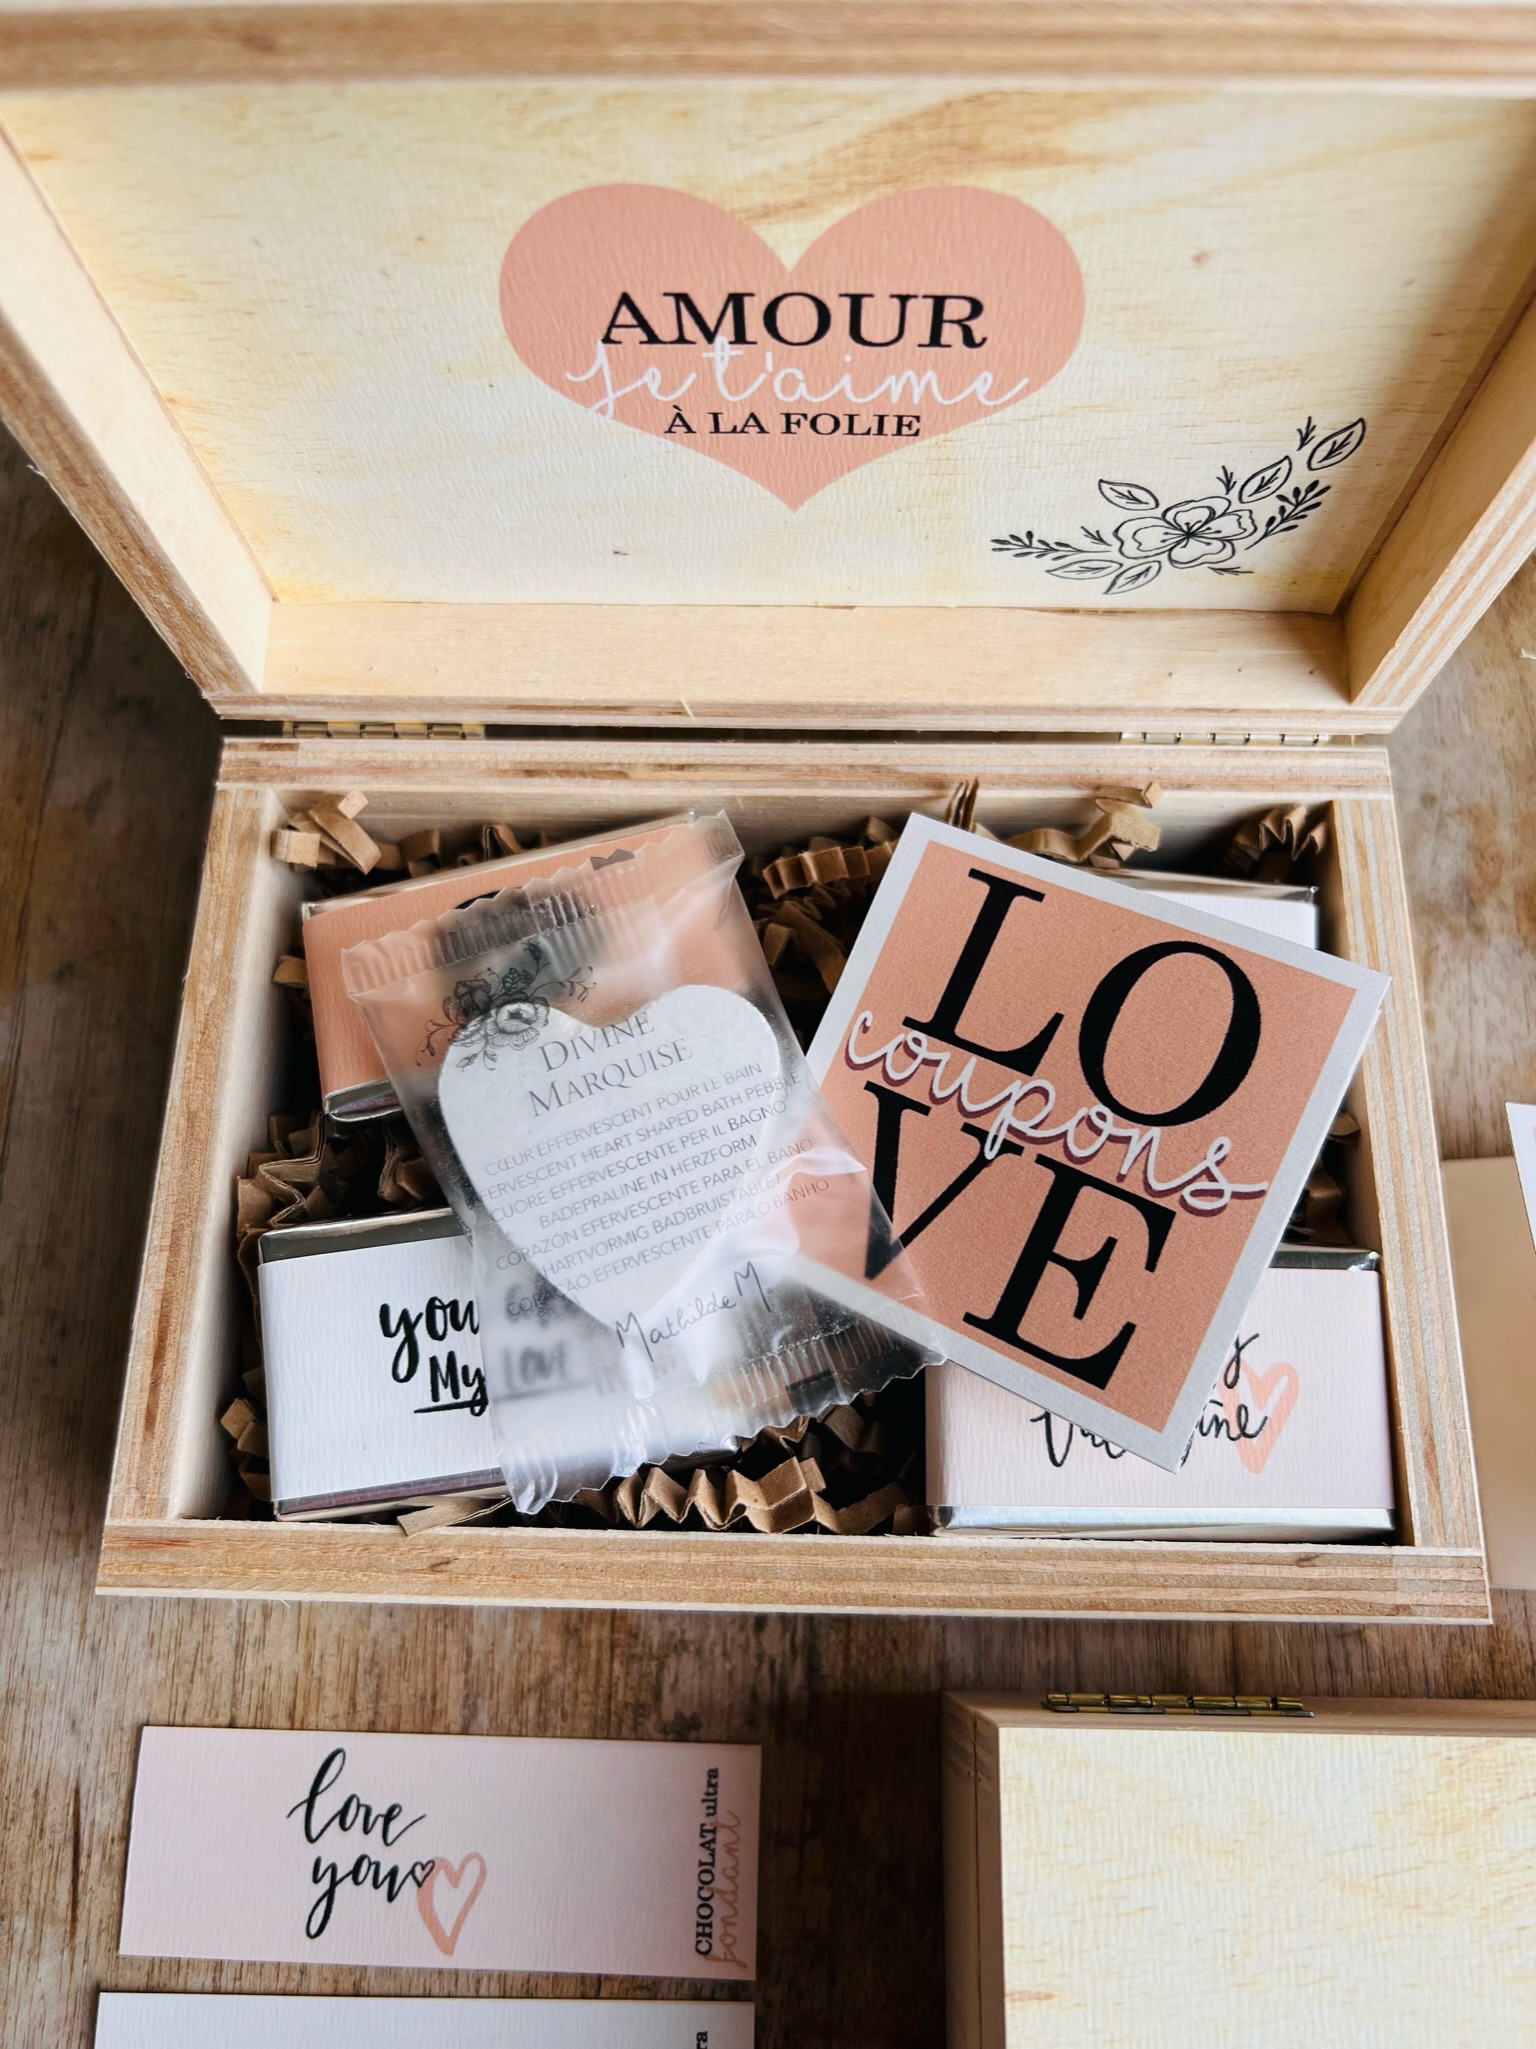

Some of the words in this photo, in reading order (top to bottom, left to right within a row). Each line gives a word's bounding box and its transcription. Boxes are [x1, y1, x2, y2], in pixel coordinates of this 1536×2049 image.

[601, 291, 988, 349] AMOUR
[664, 404, 696, 435] À
[708, 412, 770, 435] LA
[780, 412, 922, 437] FOLIE
[528, 1038, 693, 1118] MARQUISE
[538, 1011, 655, 1073] DIVINE
[468, 1154, 578, 1211] FERVESCENT
[581, 1132, 633, 1164] HEART
[636, 1109, 699, 1143] SHAPED
[701, 1091, 744, 1118] BATH
[744, 1070, 802, 1101] PEBBLE
[535, 1101, 653, 1158] EFFERVESCENT
[656, 1084, 700, 1110] POUR
[702, 1077, 722, 1094] LE
[723, 1062, 762, 1086] BAIN
[844, 1010, 1269, 1217] coupons
[490, 1190, 549, 1223] CUORE
[550, 1140, 679, 1201] EFFERVESCENTE
[679, 1129, 710, 1150] PER
[711, 1122, 727, 1138] IL
[727, 1099, 788, 1132] BAGNO
[538, 1175, 648, 1230] BADEPRALINE
[650, 1169, 669, 1186] IN
[670, 1134, 757, 1178] HERZFORM
[495, 1231, 579, 1271] CORAZÓN
[580, 1180, 702, 1238] EFERVESCENTE
[702, 1164, 745, 1190] PARA
[745, 1156, 766, 1173] EL
[542, 1225, 650, 1279] HARTVORMIG
[593, 1224, 713, 1284] EFERVESCENTE
[714, 1211, 757, 1236] PARA
[758, 1200, 771, 1217] O
[771, 1178, 829, 1210] BANHO
[614, 1291, 737, 1363] Mathilde
[429, 1350, 488, 1417] My
[287, 1747, 426, 1846] love
[701, 1767, 719, 1818] ultra
[305, 1851, 419, 1939] you
[694, 1822, 717, 1957] CHOCOLAT
[703, 1808, 748, 1970] fondant
